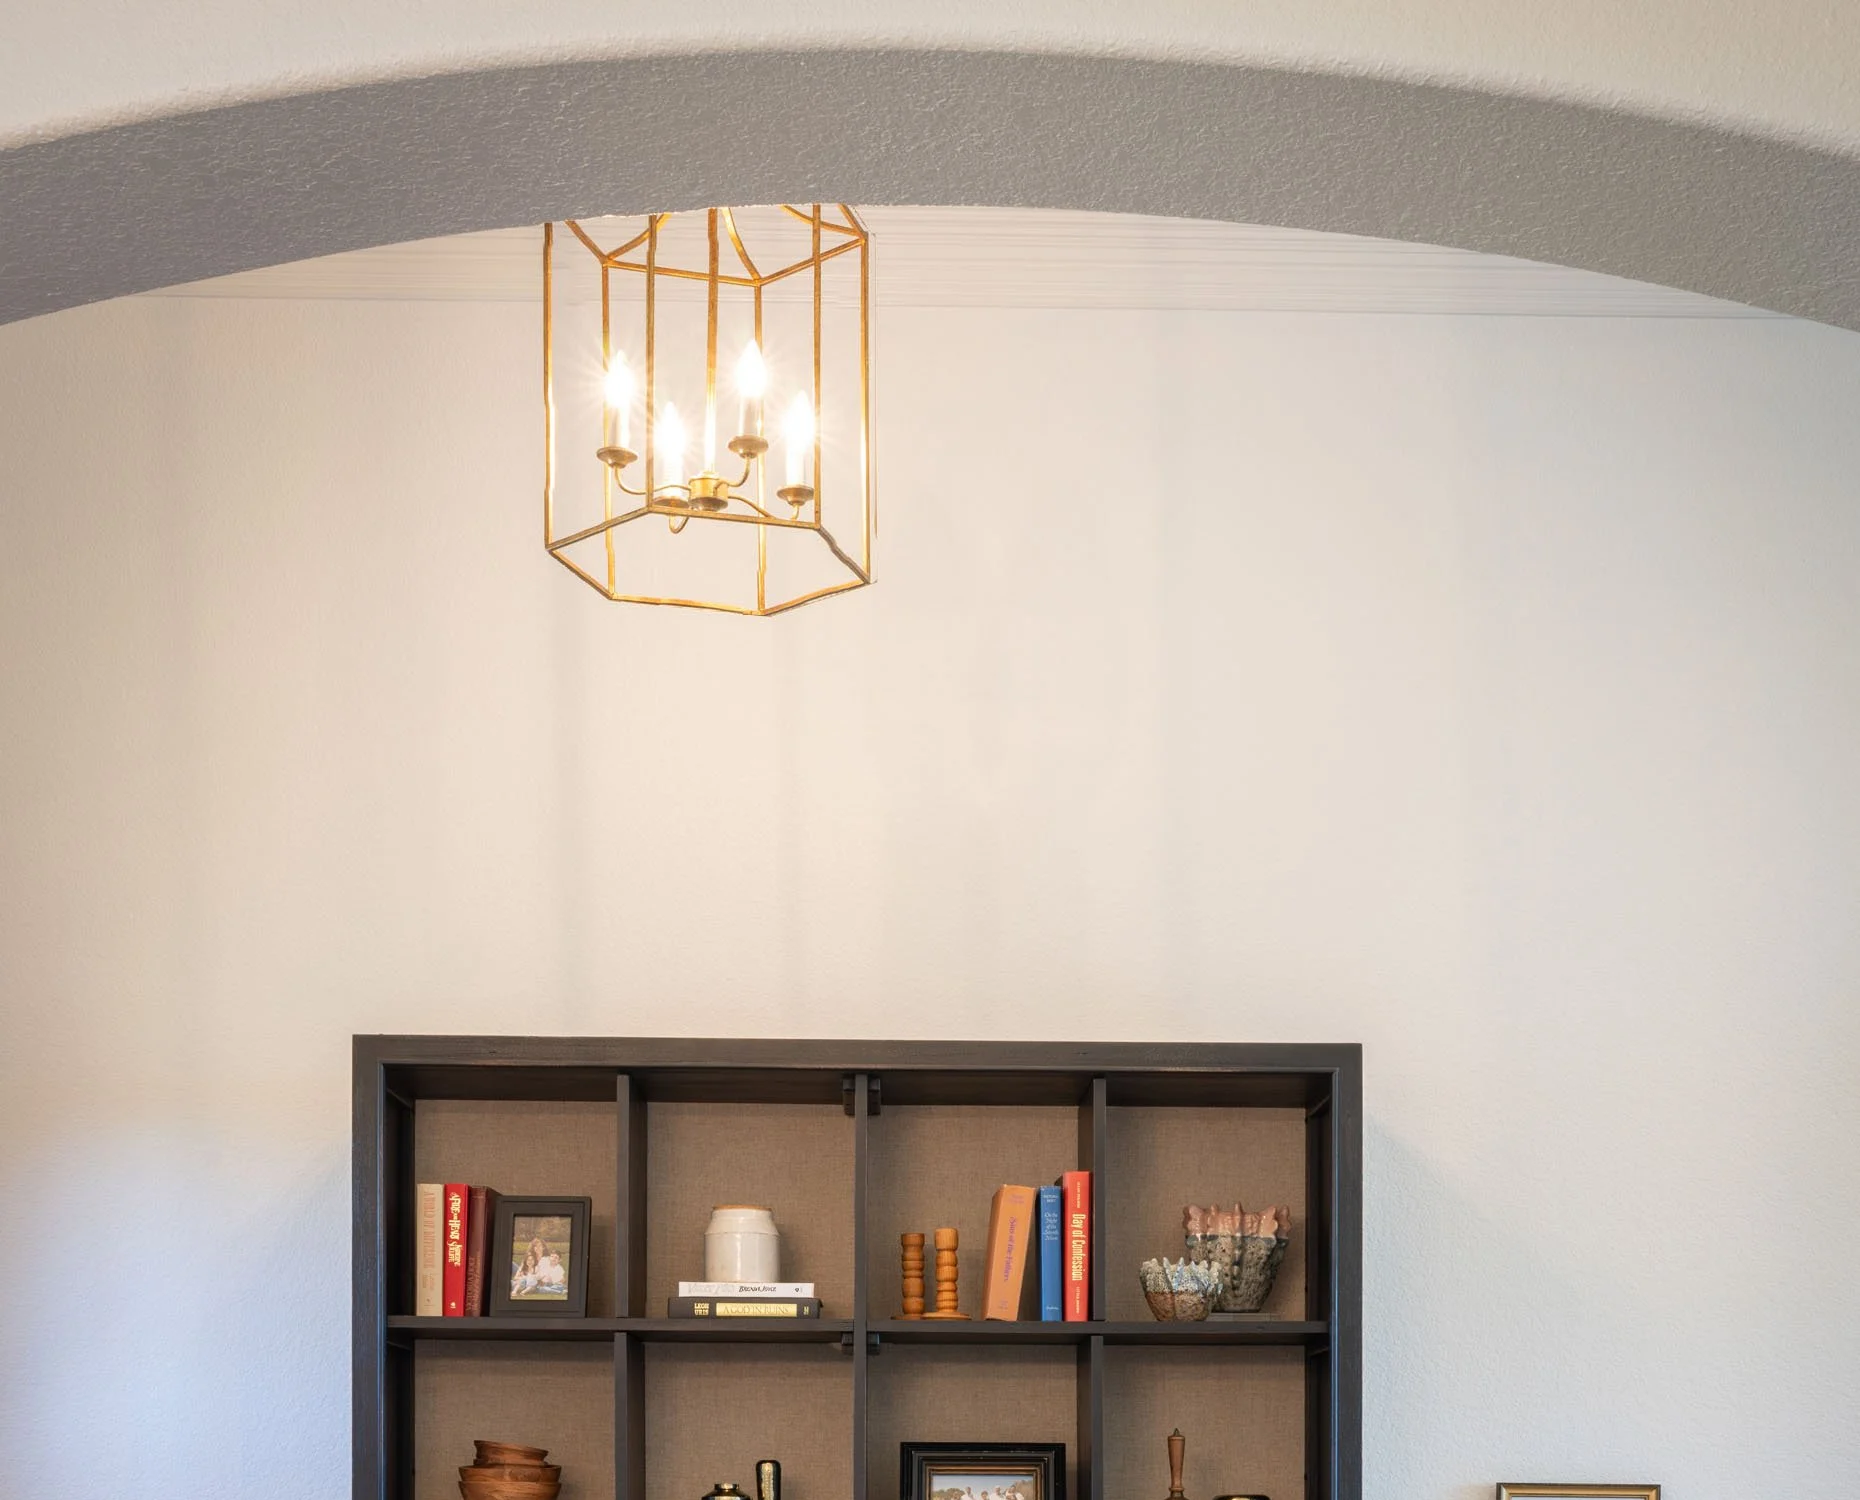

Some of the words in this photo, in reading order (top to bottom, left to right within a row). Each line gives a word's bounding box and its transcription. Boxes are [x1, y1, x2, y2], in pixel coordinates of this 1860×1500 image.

[1070, 1213, 1086, 1228] Day
[1003, 1256, 1014, 1282] Fathers
[1071, 1239, 1086, 1281] Confession
[730, 1305, 750, 1314] GOD
[752, 1306, 761, 1315] IN
